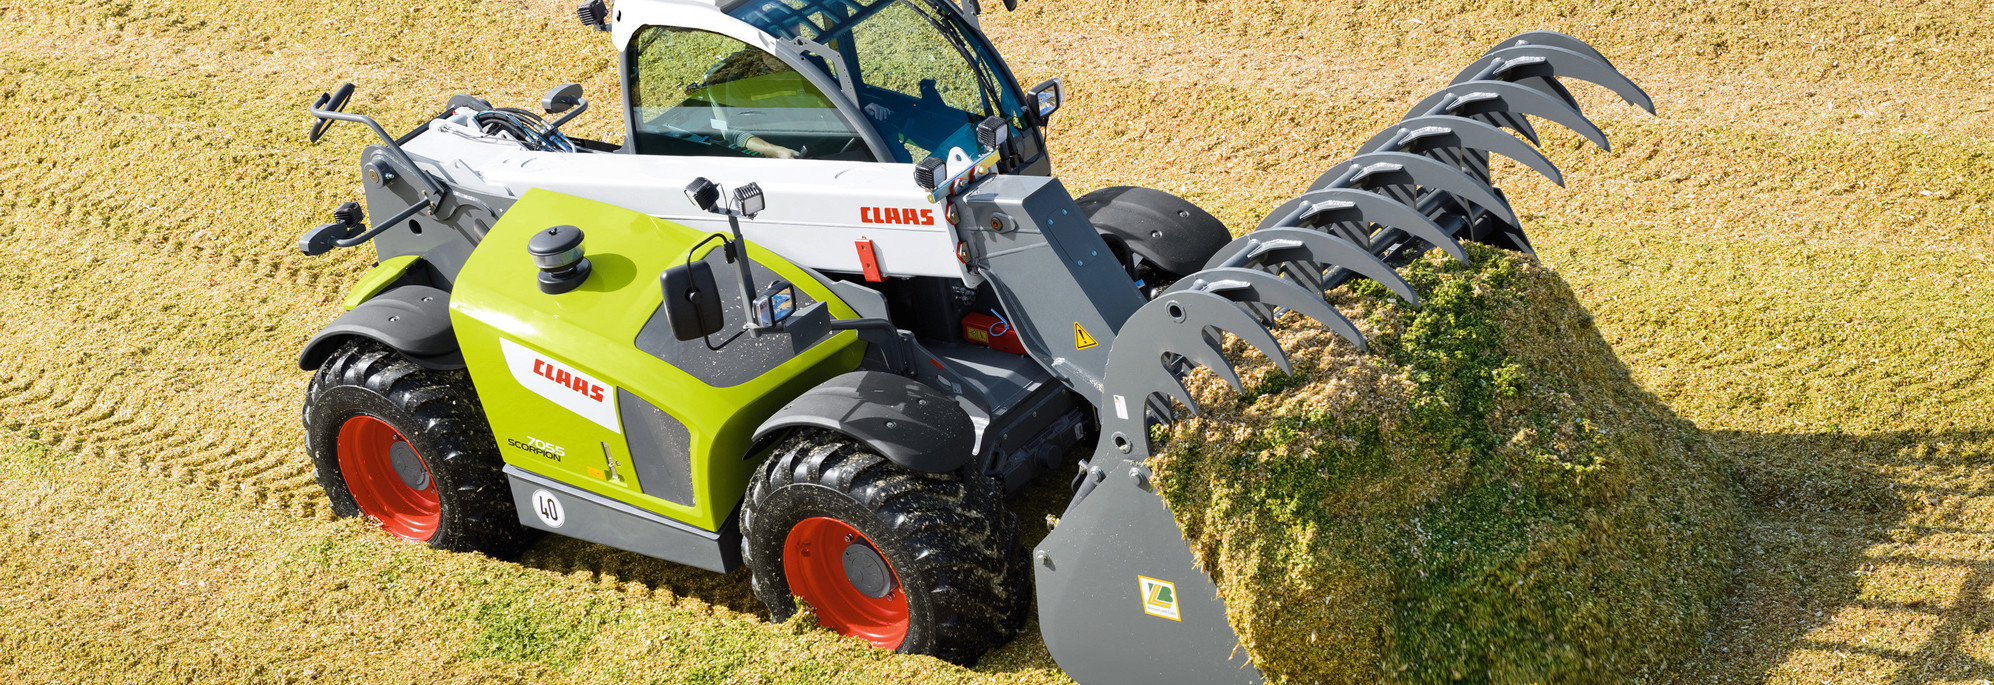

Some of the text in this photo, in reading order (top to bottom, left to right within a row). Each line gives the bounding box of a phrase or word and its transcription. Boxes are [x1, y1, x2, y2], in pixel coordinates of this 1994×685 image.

[860, 206, 935, 226] CLAAS
[533, 358, 605, 403] CLAAS
[507, 438, 562, 463] SCORPION
[527, 436, 566, 457] 7055
[539, 495, 559, 521] 40
